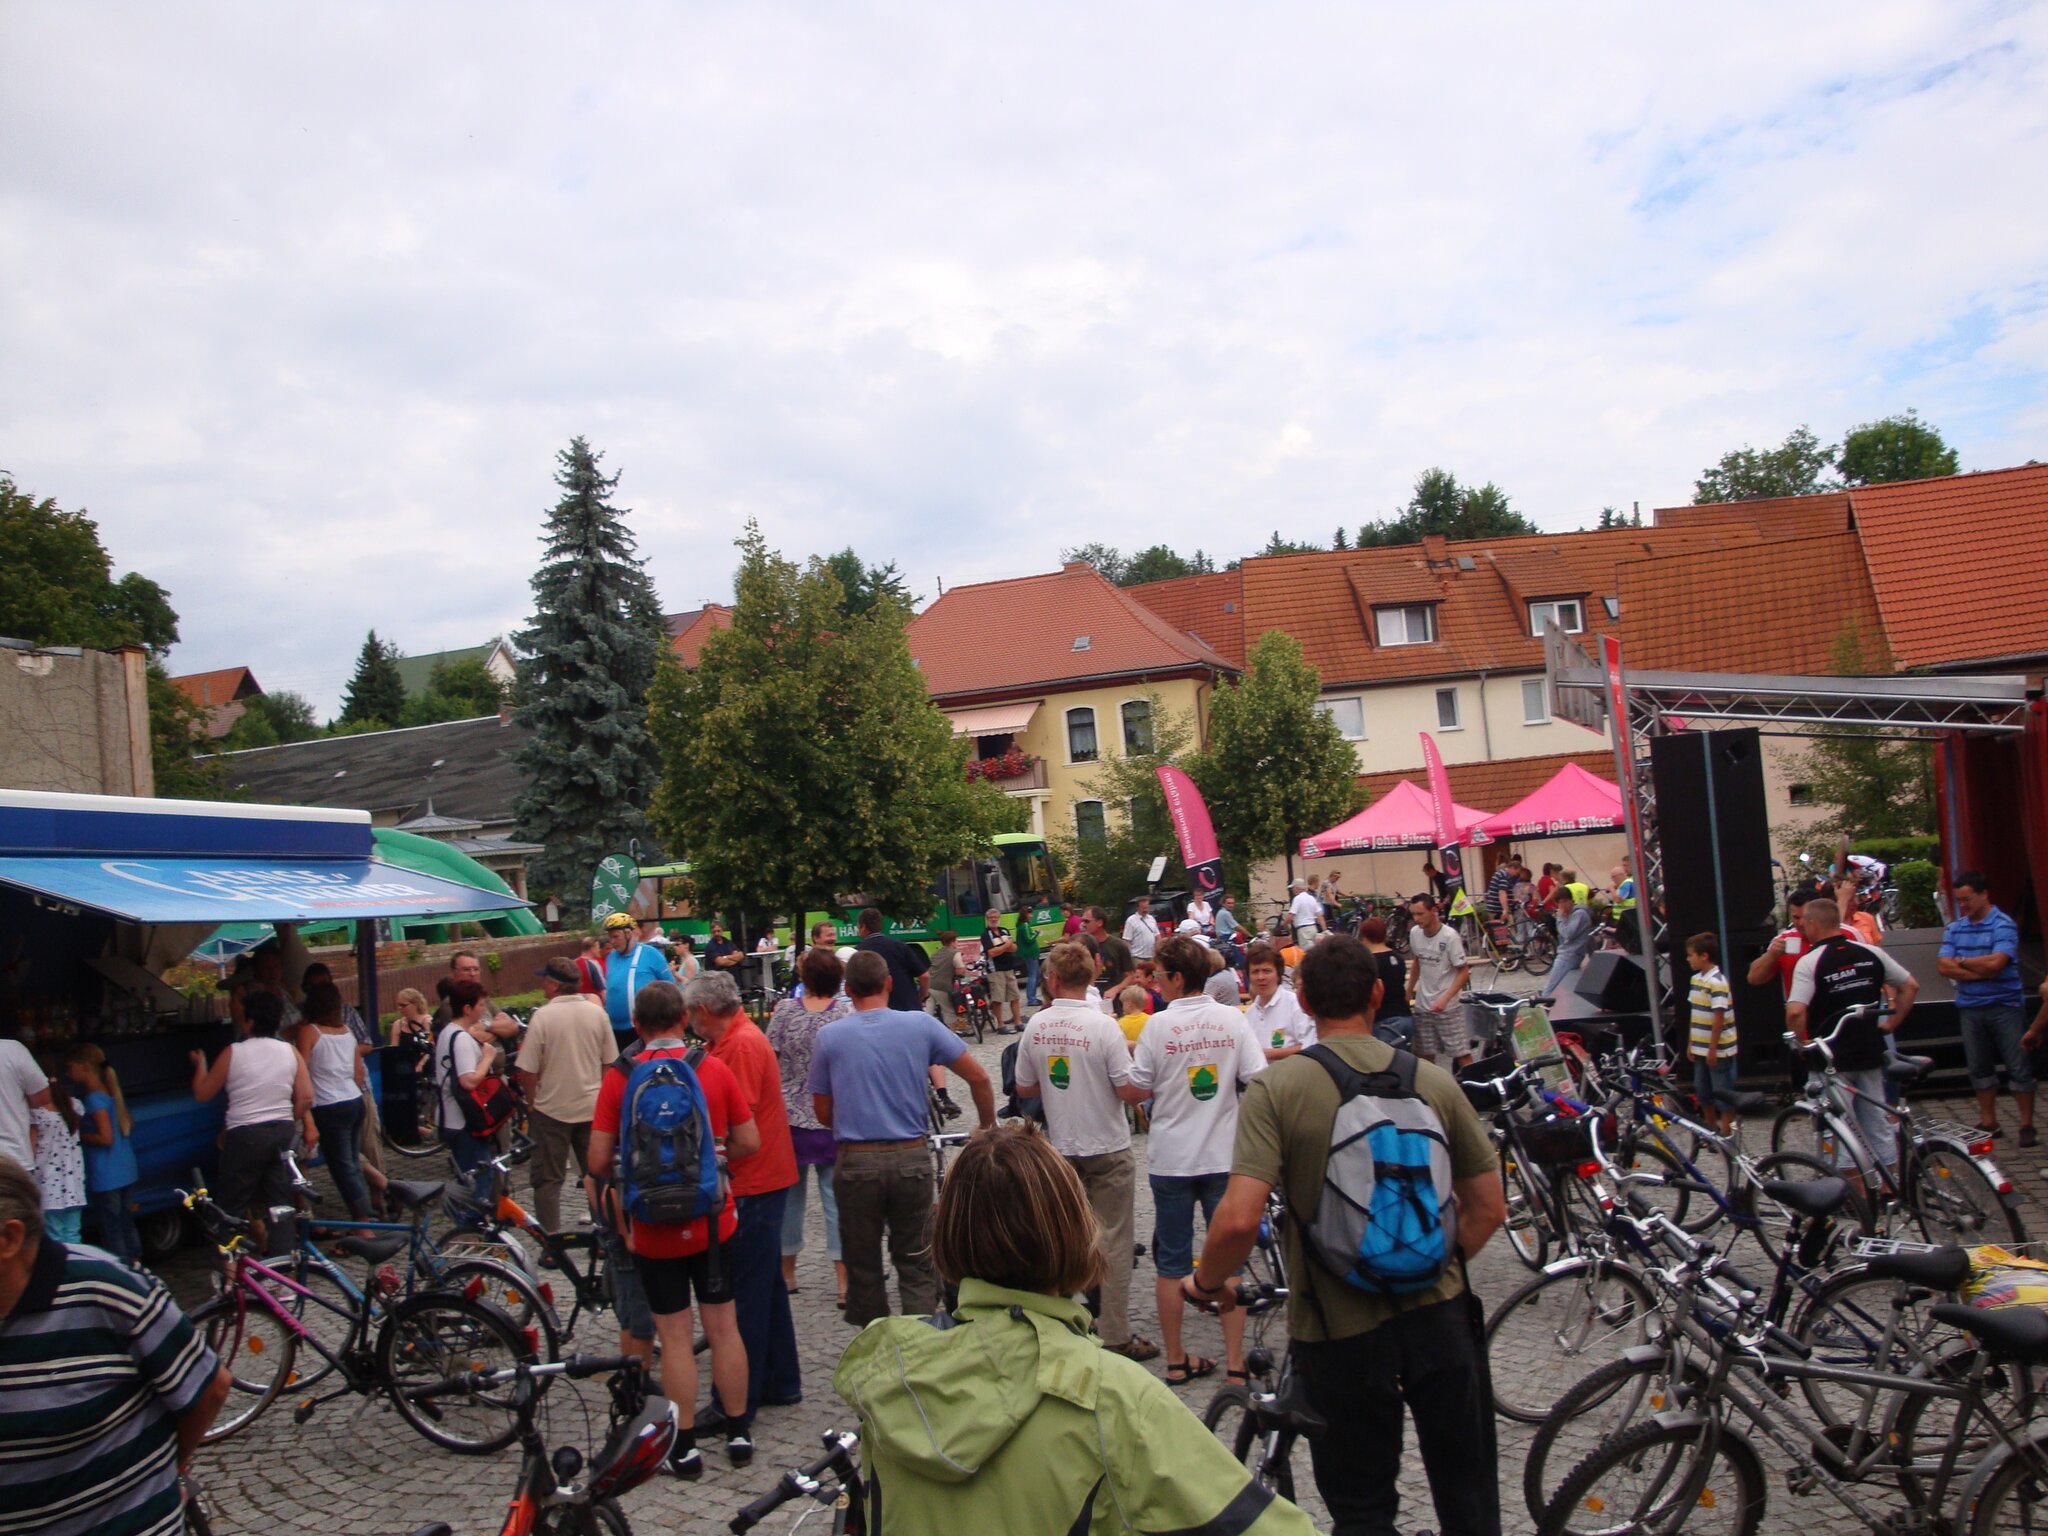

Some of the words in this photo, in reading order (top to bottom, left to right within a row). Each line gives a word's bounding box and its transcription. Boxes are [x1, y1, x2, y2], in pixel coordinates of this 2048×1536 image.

[1511, 822, 1543, 836] Little
[1546, 819, 1575, 835] John
[1578, 815, 1614, 829] Bikes
[1341, 837, 1370, 849] Little
[1372, 835, 1398, 849] John
[1401, 833, 1433, 845] Bikes
[600, 857, 624, 878] AOK
[592, 899, 614, 922] AOK
[840, 924, 861, 936] HÄN
[1823, 968, 1857, 983] TEAM
[1033, 1033, 1091, 1052] Steinbach
[1165, 1035, 1235, 1055] Steinbach
